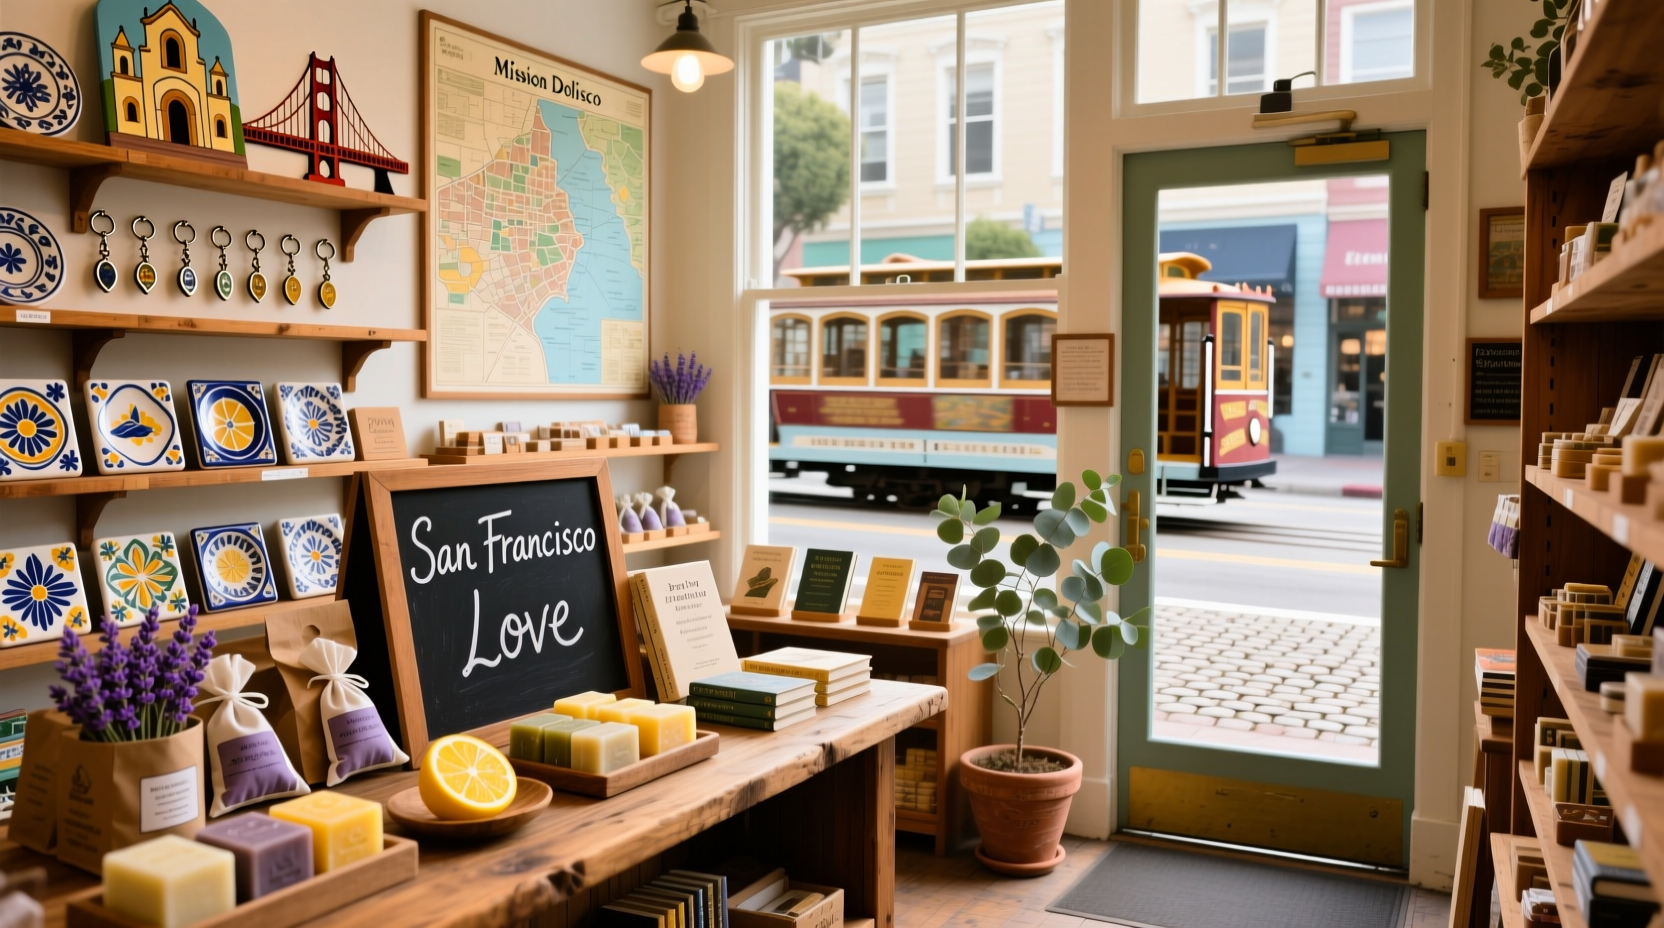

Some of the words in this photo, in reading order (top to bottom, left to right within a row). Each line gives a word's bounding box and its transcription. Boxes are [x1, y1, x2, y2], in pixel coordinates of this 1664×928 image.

[494, 56, 547, 89] Mission
[552, 75, 601, 106] Dolisco
[411, 516, 477, 584] San
[478, 510, 596, 574] Francisco
[462, 589, 584, 677] Love
